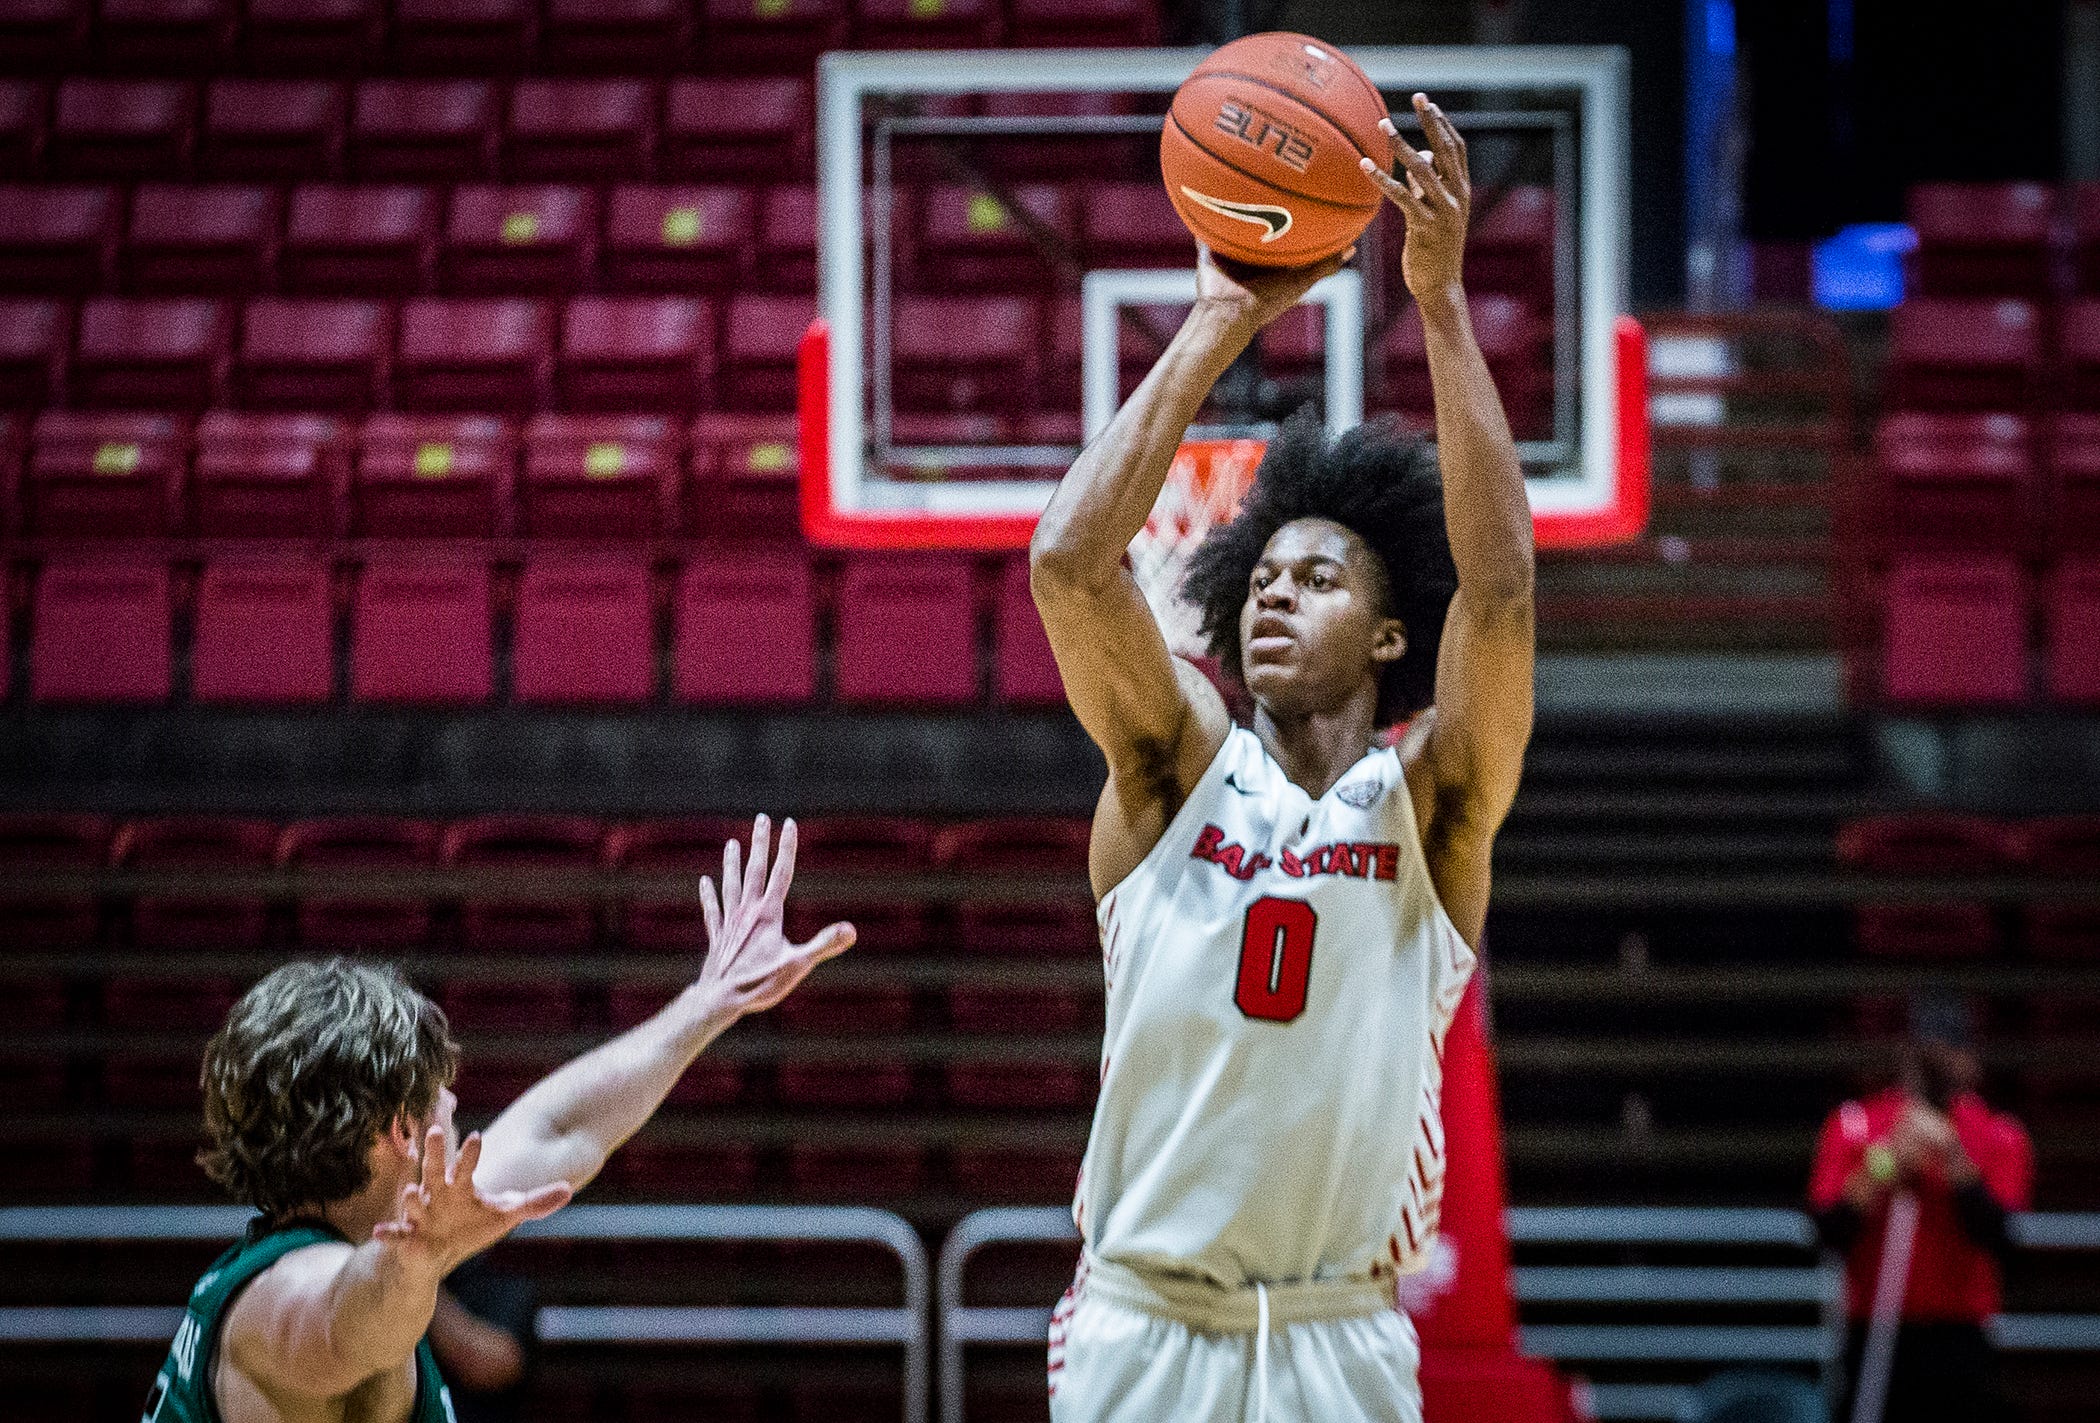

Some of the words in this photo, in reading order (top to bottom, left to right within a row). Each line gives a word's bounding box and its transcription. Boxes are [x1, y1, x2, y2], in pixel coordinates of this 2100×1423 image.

[1214, 102, 1313, 173] ELITE
[1279, 843, 1399, 881] STATE
[1234, 896, 1318, 1022] 0
